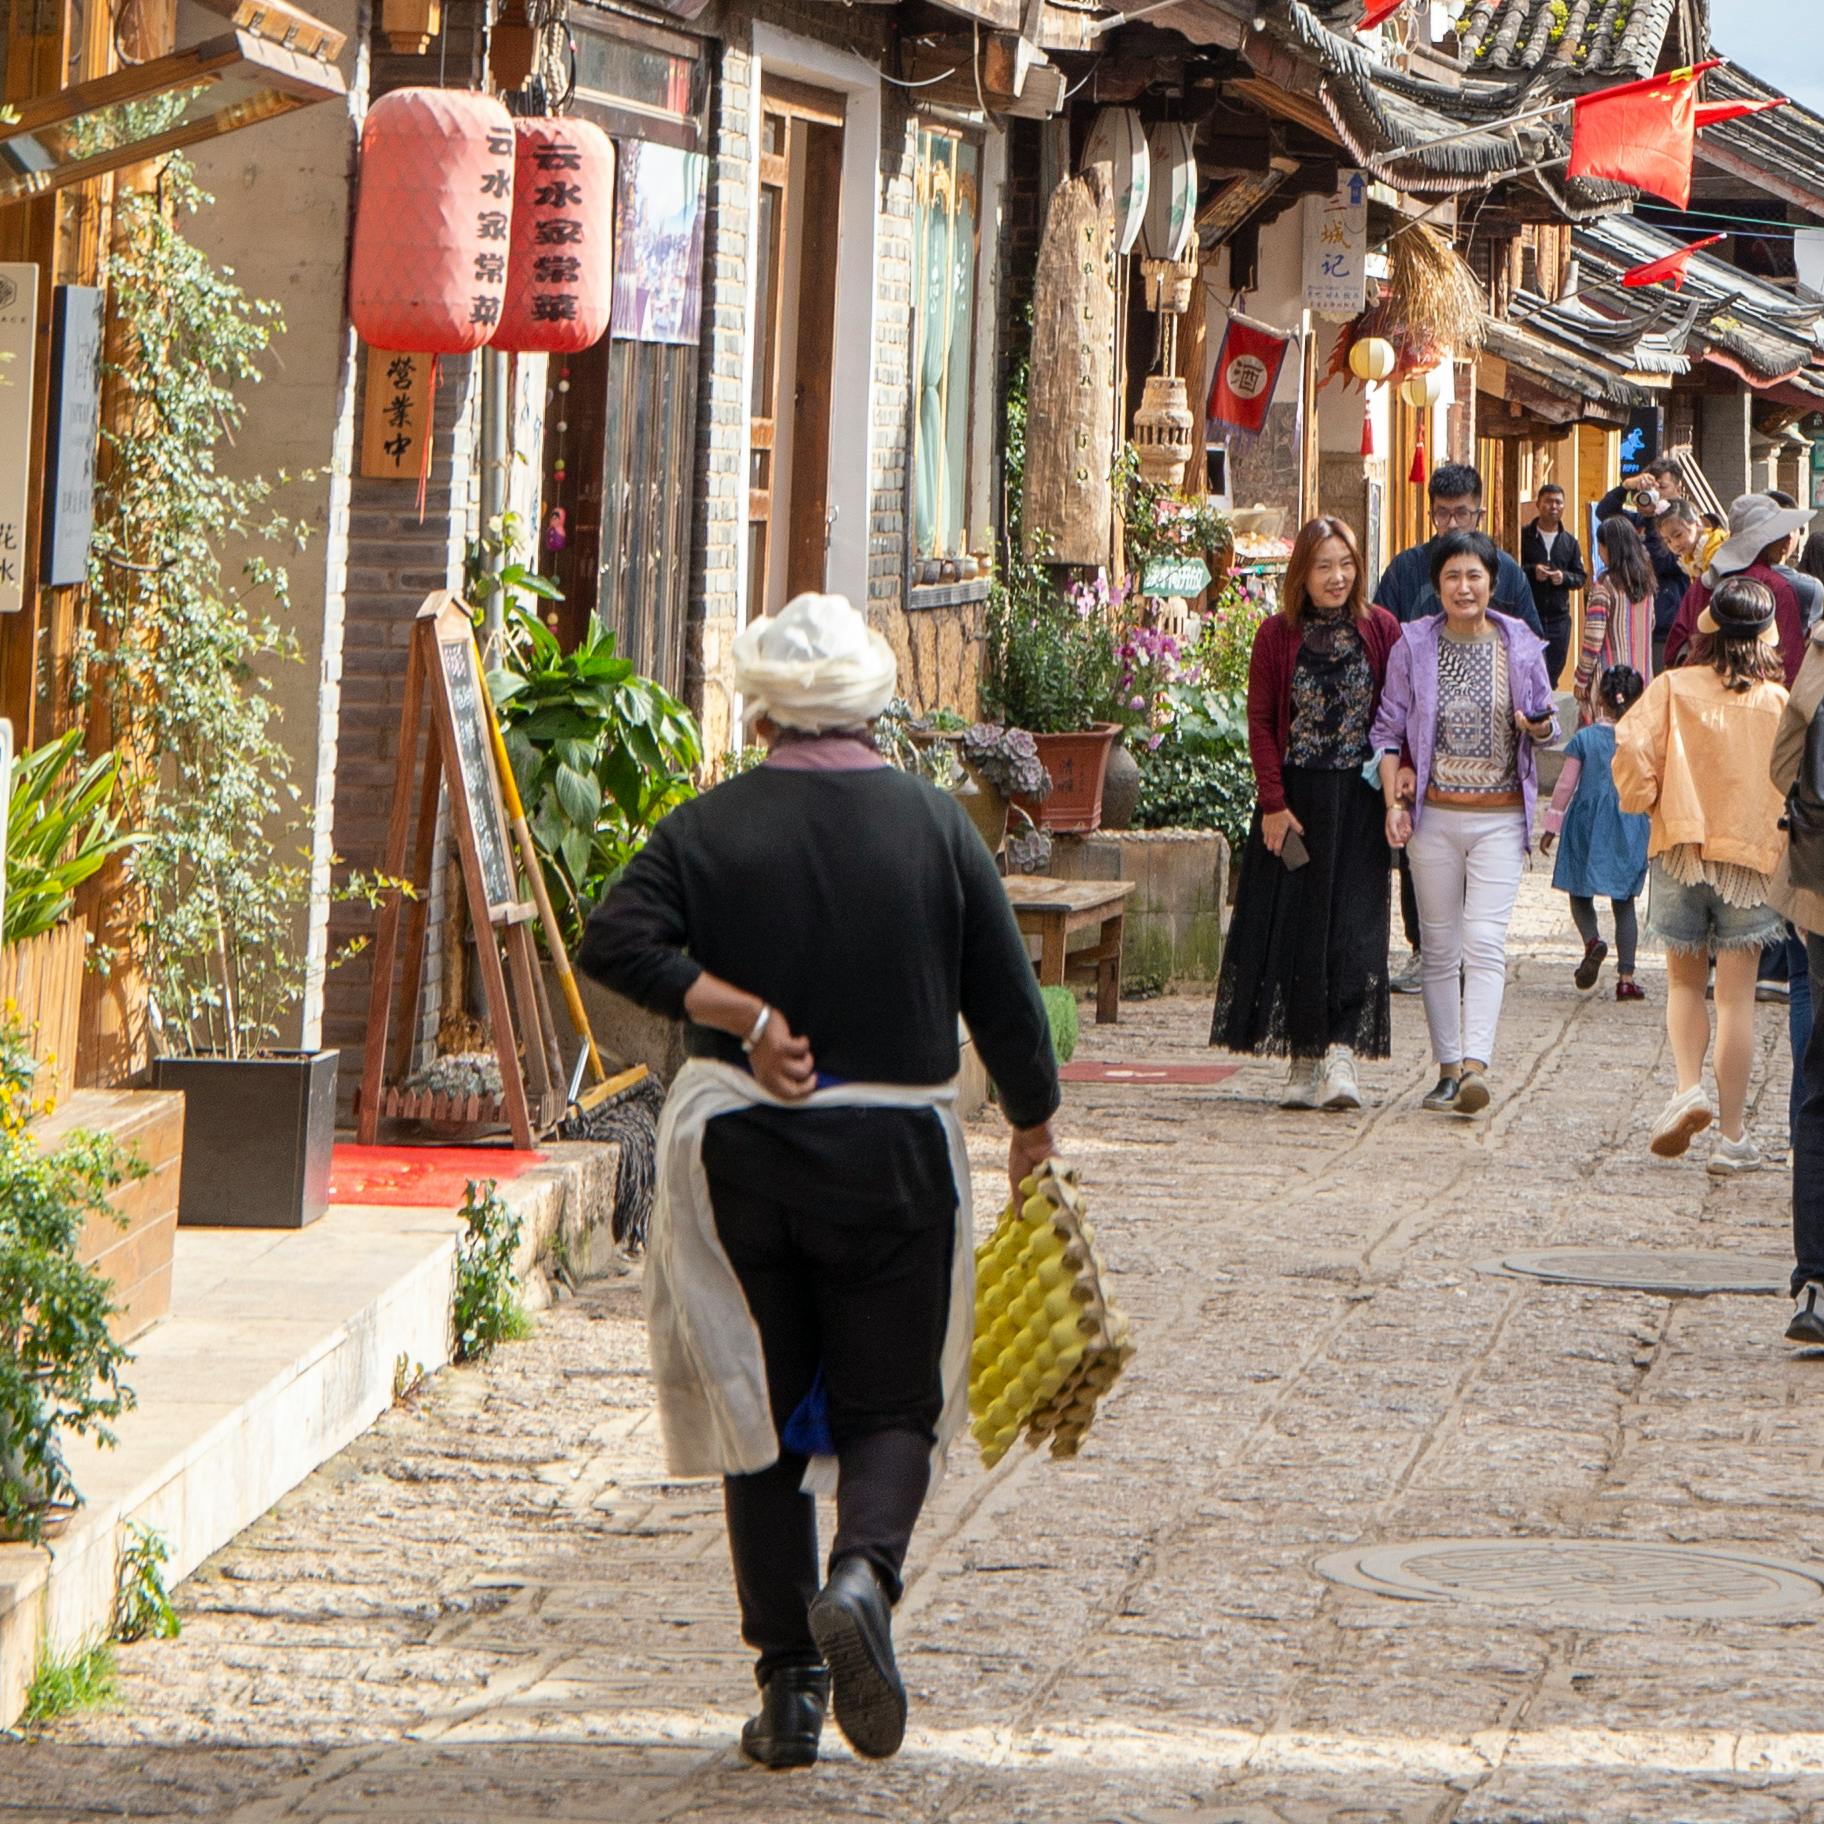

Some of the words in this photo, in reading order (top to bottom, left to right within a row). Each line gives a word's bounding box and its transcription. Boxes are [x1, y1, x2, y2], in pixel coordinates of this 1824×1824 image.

[469, 126, 513, 327] 云水家常菜
[531, 143, 583, 323] 云水家常菜
[1230, 359, 1264, 394] 酒
